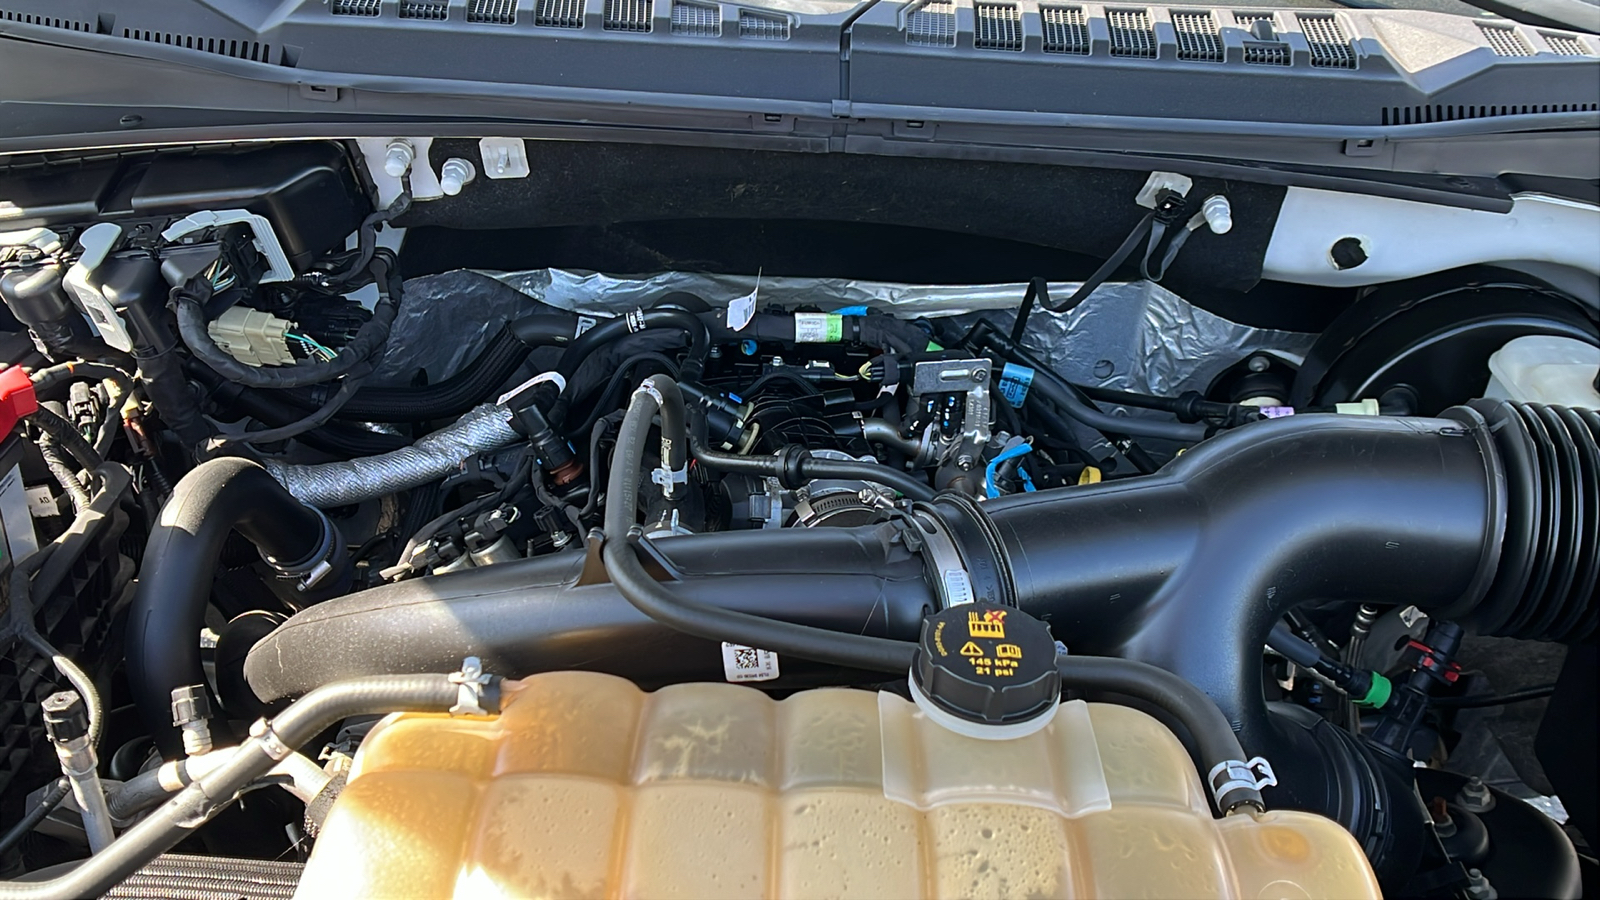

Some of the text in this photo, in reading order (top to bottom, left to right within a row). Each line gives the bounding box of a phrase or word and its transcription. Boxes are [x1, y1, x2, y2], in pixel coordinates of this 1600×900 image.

[968, 657, 1019, 668] 145 kPa
[975, 666, 1014, 677] 21 psi
